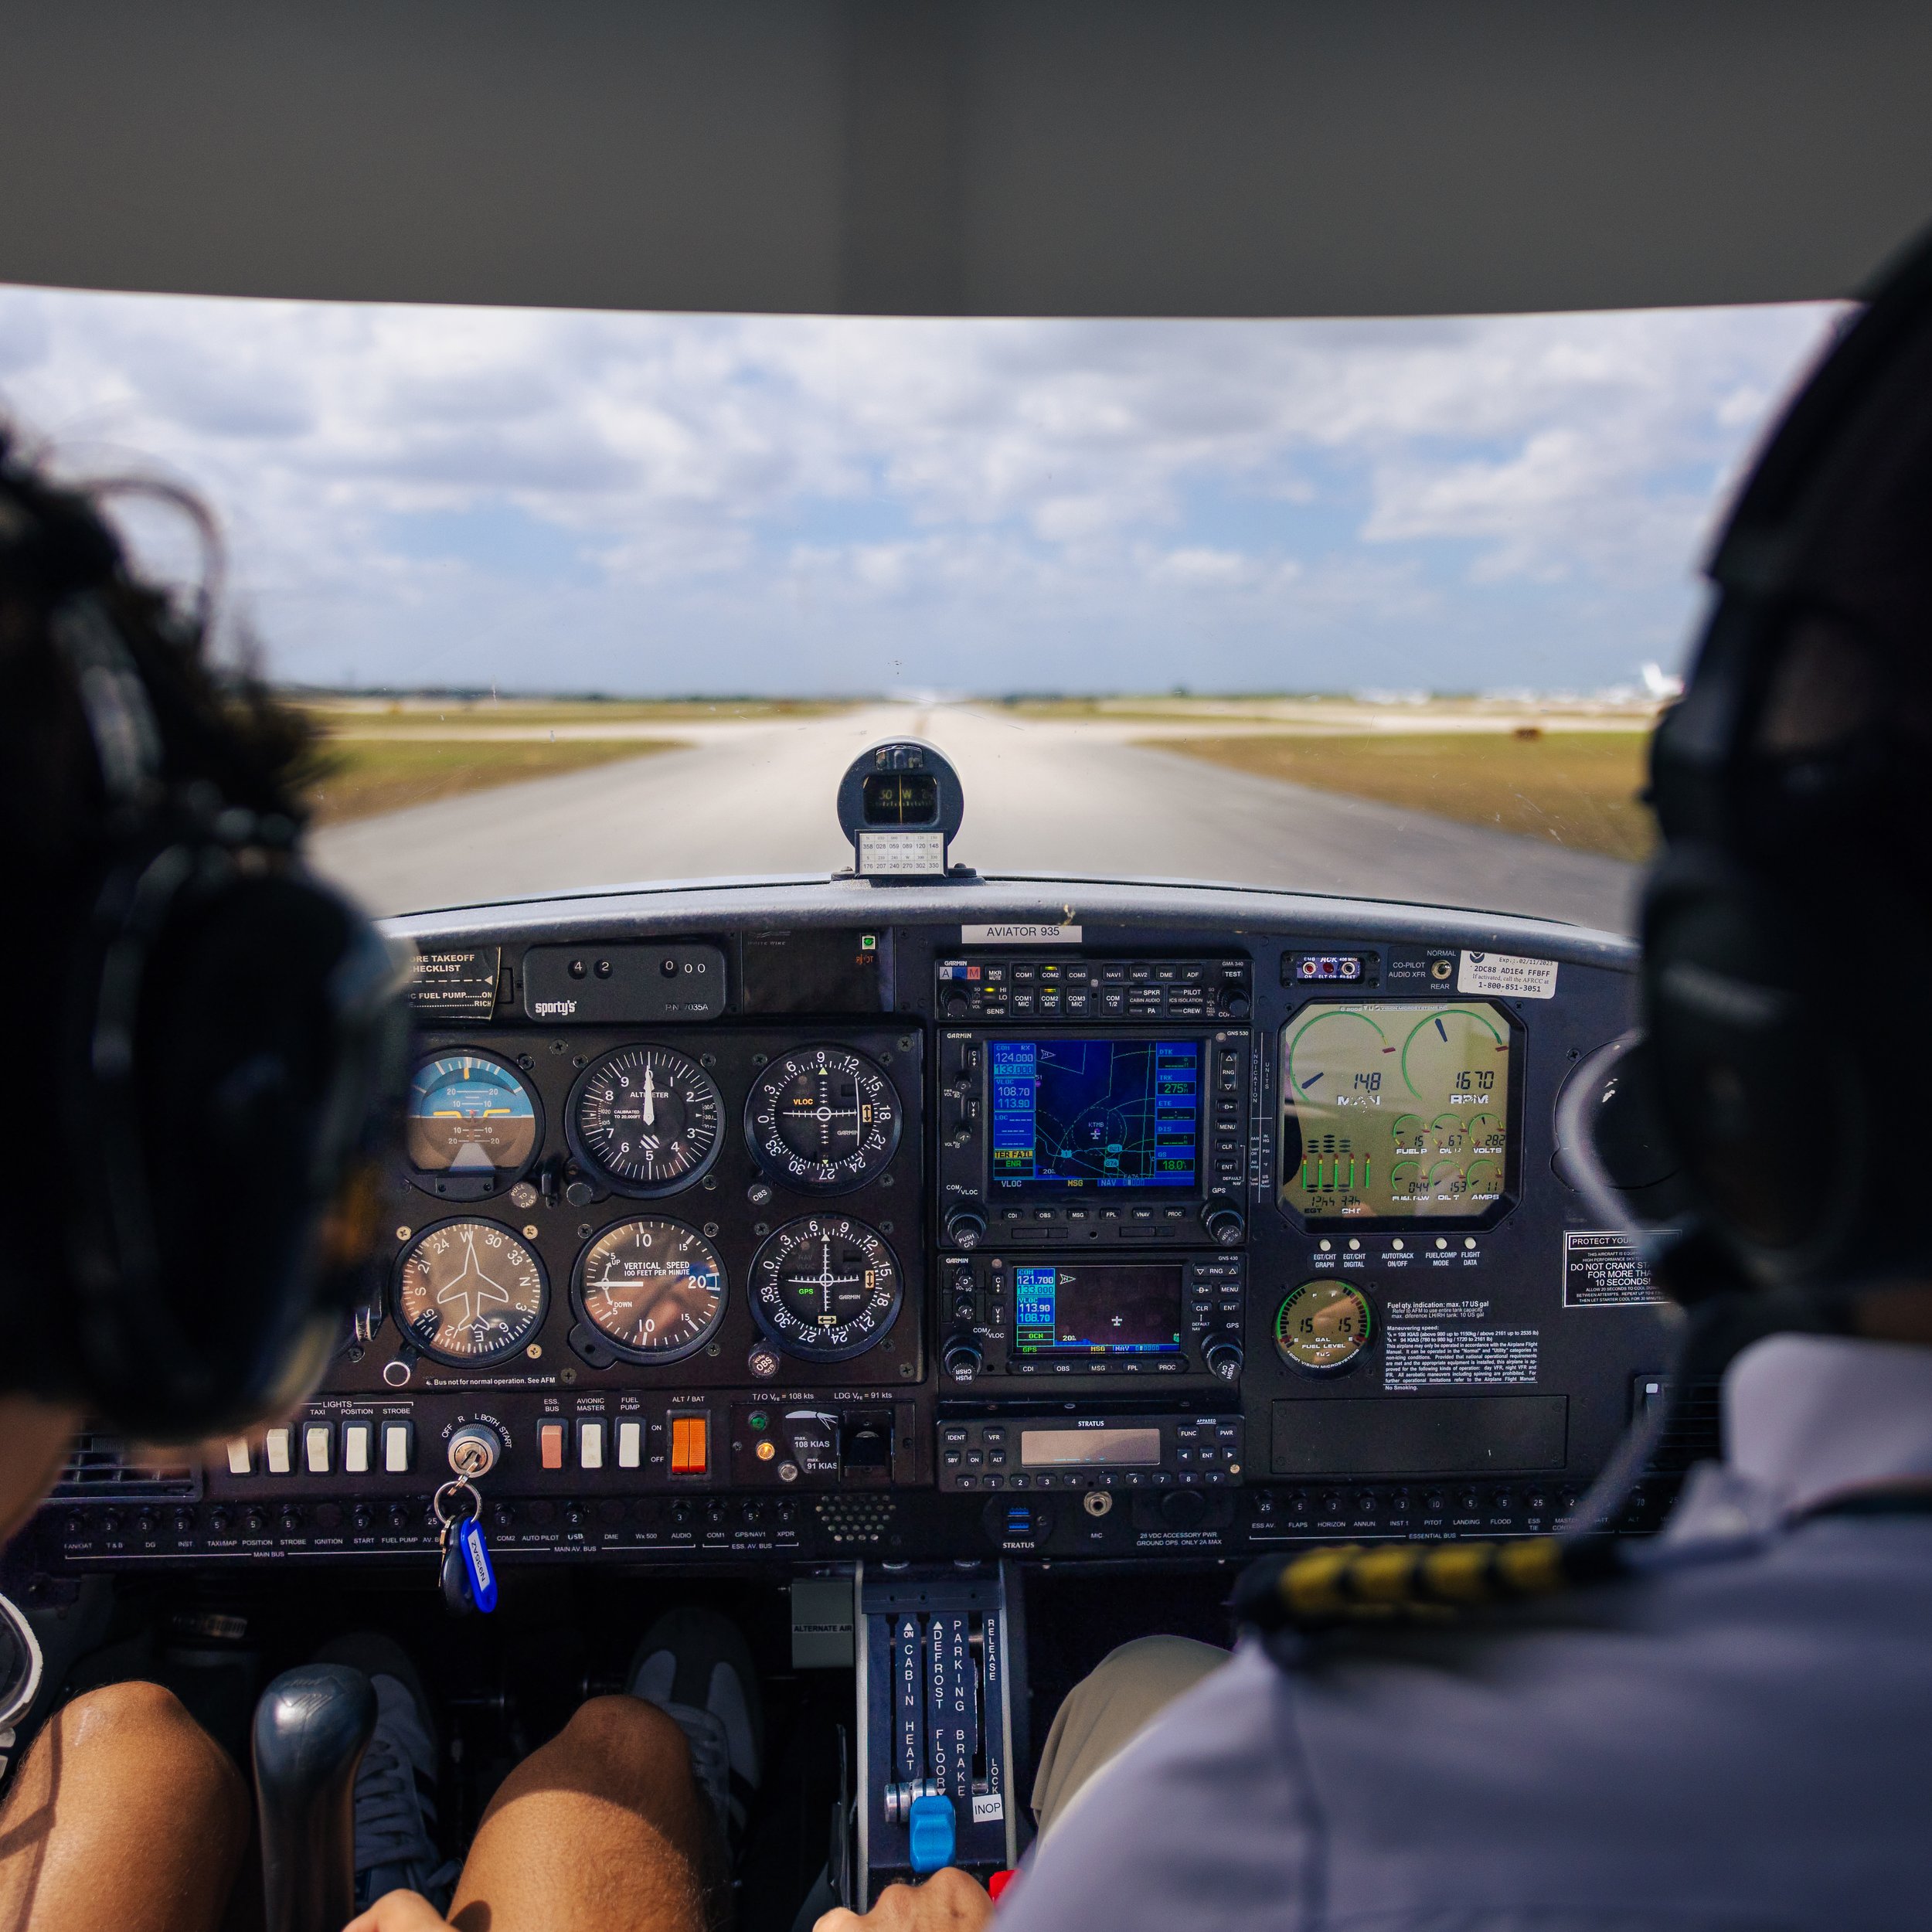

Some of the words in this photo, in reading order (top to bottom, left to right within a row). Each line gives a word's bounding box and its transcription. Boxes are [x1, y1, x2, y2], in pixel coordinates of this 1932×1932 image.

[987, 927, 1036, 937] AVIATOR
[1040, 927, 1060, 936] 935
[1475, 965, 1496, 974] 2DC88
[1478, 981, 1541, 992] 1-800-851-3051
[536, 1001, 577, 1015] sporty's
[995, 1053, 1033, 1062] 124.000
[1456, 1071, 1494, 1090] 1670
[998, 1087, 1029, 1096] 108.70
[998, 1099, 1029, 1108] 113.90
[1450, 1095, 1488, 1104] RPM
[635, 1234, 652, 1247] 10
[689, 1276, 706, 1288] 20
[638, 1319, 655, 1332] 10
[498, 1426, 512, 1448] START
[471, 1540, 486, 1582] N935AZ
[934, 1631, 944, 1709] DEFROST
[954, 1621, 964, 1711] PARKING
[905, 1645, 913, 1706] CABIN
[906, 1722, 914, 1770] HEAT
[936, 1730, 945, 1787] FLOOR
[956, 1730, 965, 1796] BRAKE
[975, 1803, 1000, 1815] INOP
